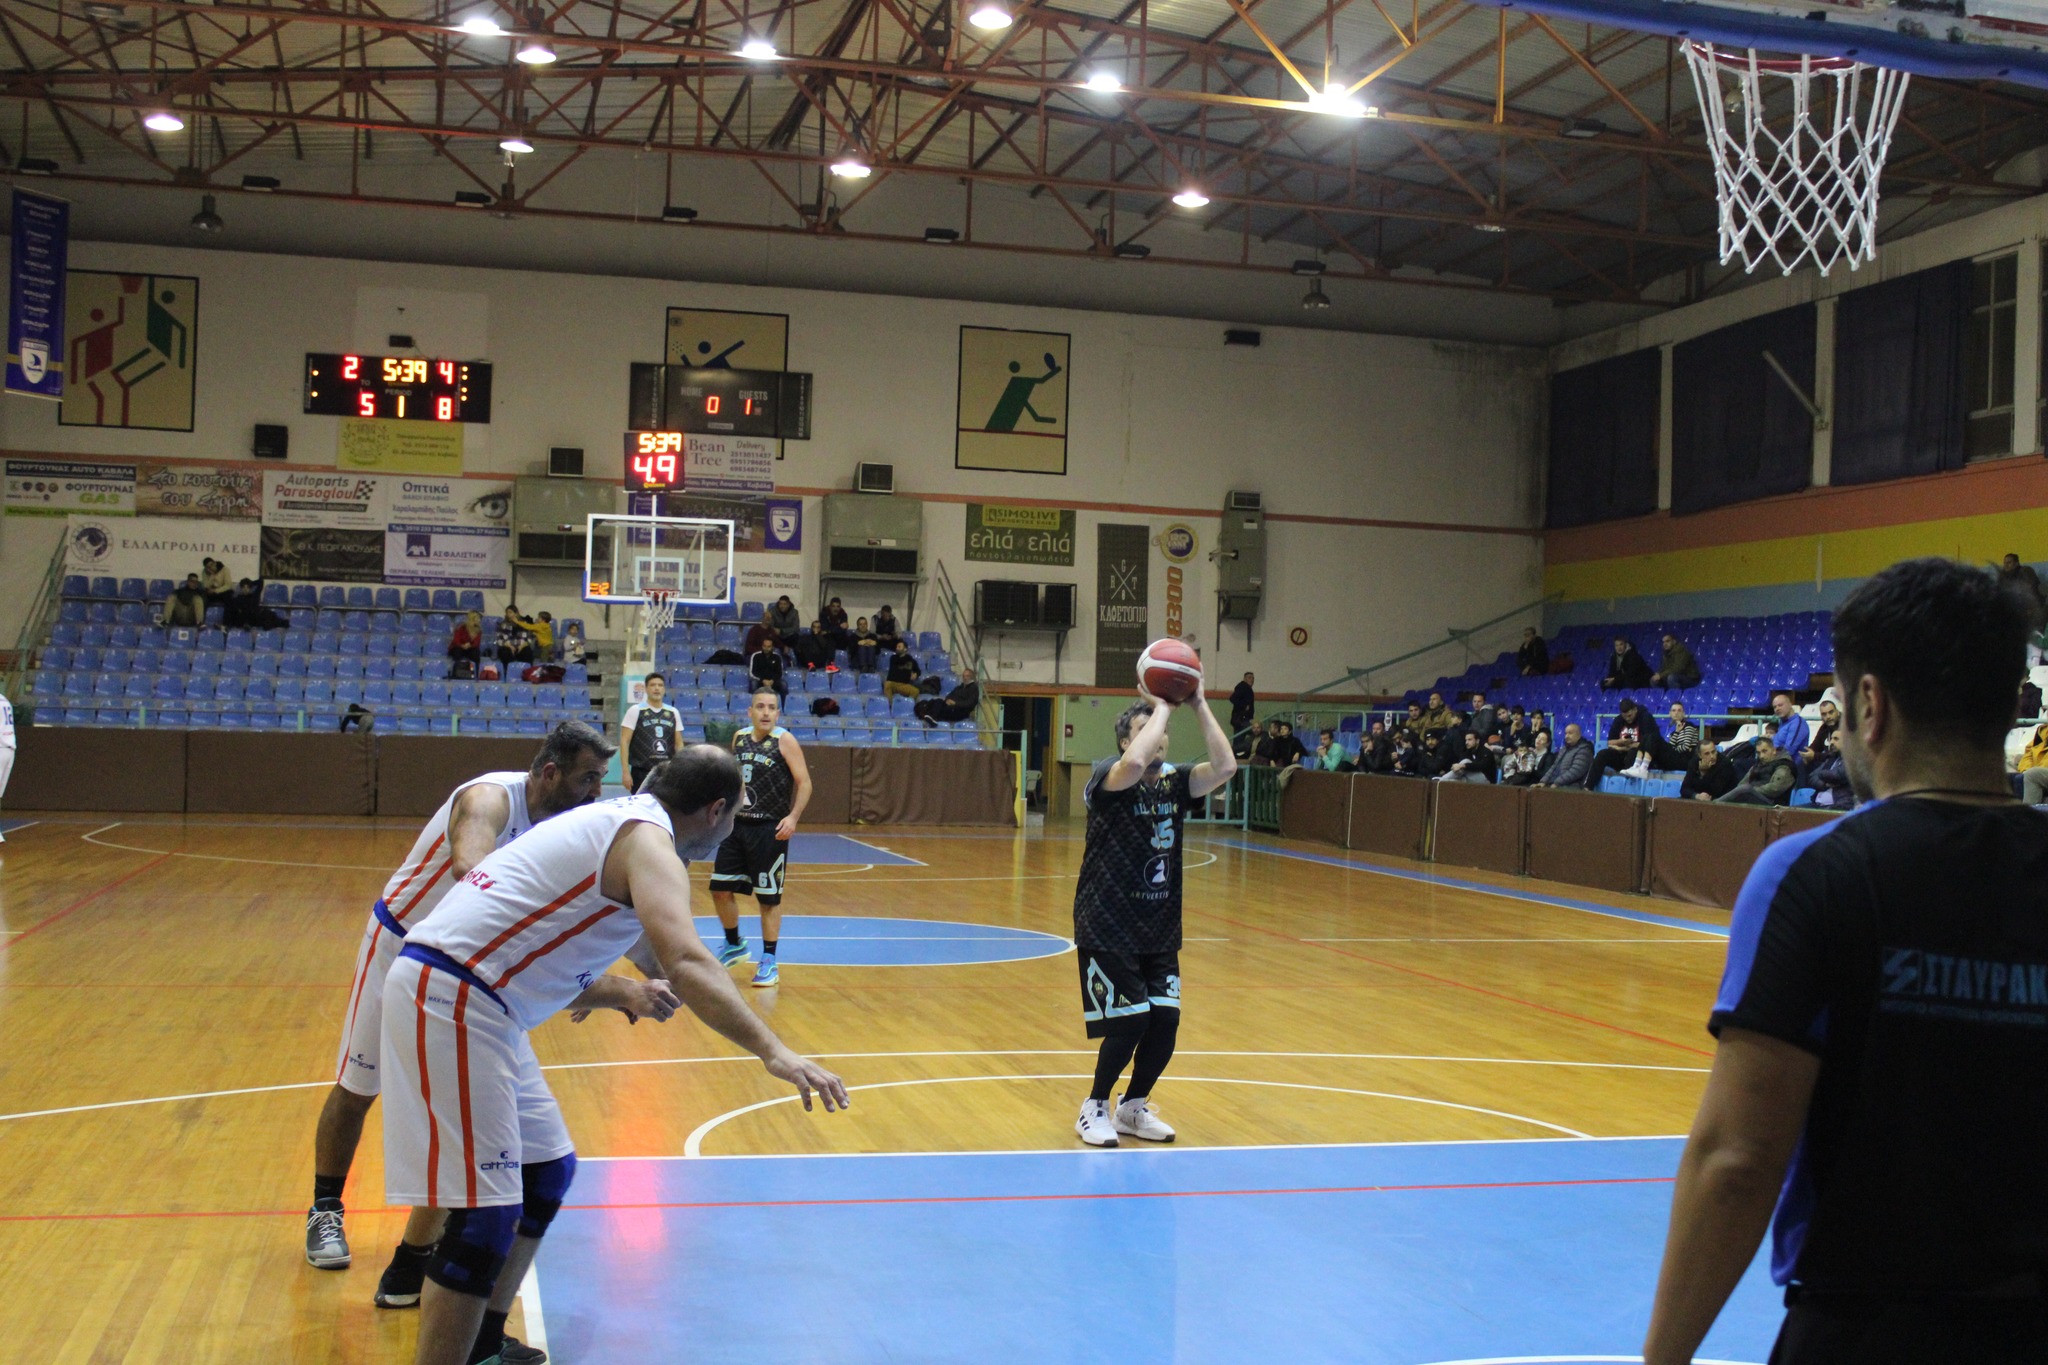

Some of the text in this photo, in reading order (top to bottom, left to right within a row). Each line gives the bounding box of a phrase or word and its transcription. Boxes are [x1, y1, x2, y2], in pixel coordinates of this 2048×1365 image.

[344, 356, 359, 380] 2
[383, 358, 427, 383] 5:39
[440, 362, 453, 385] 4
[681, 386, 703, 397] HOME
[739, 390, 768, 400] GUESTS
[360, 393, 375, 416] 5
[398, 395, 405, 418] 1
[438, 397, 452, 420] 8
[707, 395, 720, 414] 0
[745, 398, 752, 415] 1
[638, 432, 682, 453] 5:39
[688, 439, 725, 452] Bean
[736, 439, 766, 451] Delivery
[692, 453, 722, 466] Tree
[633, 455, 677, 483] 4.9
[65, 483, 134, 493] ΦΟΥΡΤΟΥΝΑΣ
[285, 474, 349, 488] Autoparts
[402, 481, 449, 494] Οπτικά
[79, 492, 120, 504] GAS
[275, 485, 354, 502] Parasoglou
[996, 508, 1057, 521] SIMOLIVE
[122, 539, 258, 554] ΕΛΛΑΓΡΟΛΙΠ ΑΕΒΕ
[970, 529, 1070, 553] ελιά ελιά
[1166, 566, 1183, 637] 8300
[1099, 605, 1147, 623] ΚΑΦΕΤΟΠΙΟ
[758, 872, 767, 887] 6
